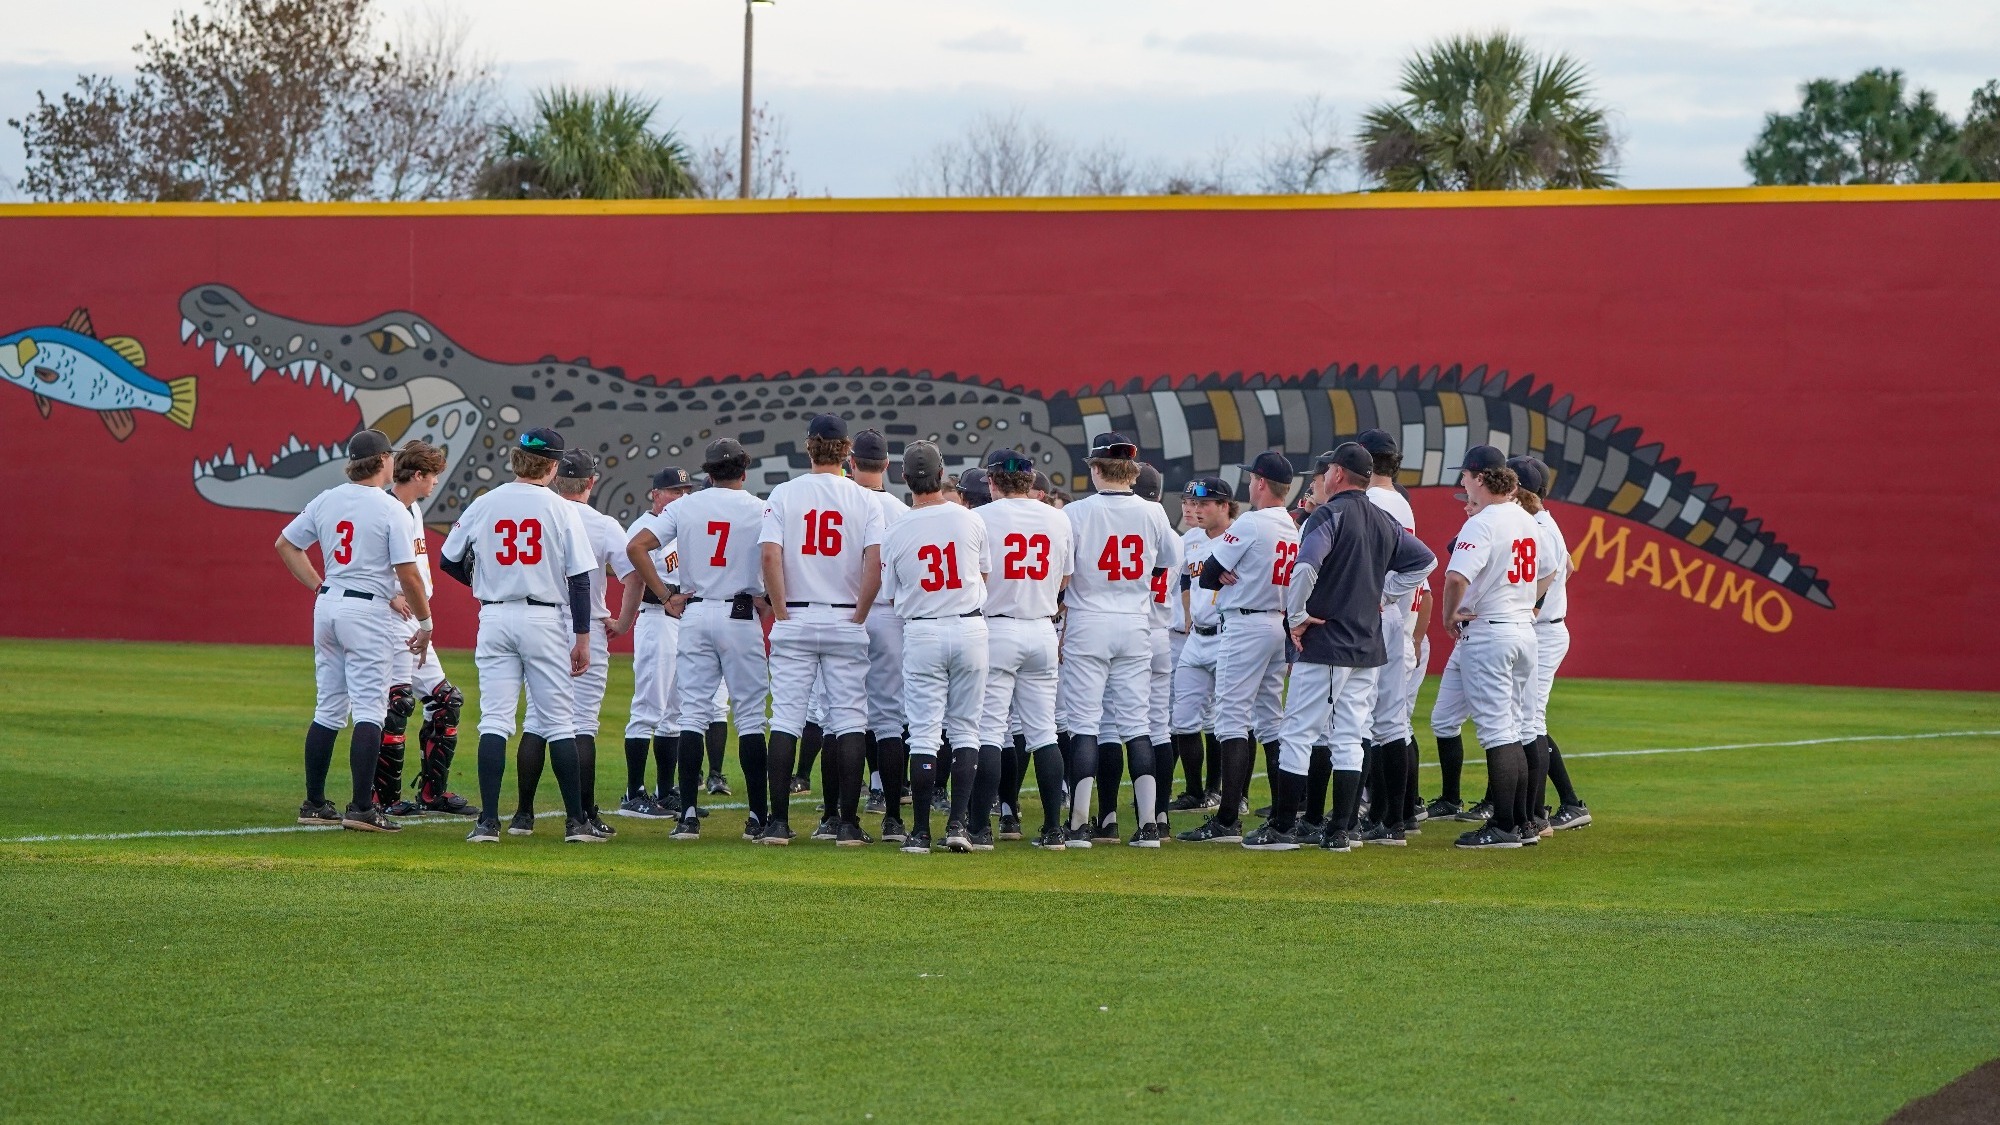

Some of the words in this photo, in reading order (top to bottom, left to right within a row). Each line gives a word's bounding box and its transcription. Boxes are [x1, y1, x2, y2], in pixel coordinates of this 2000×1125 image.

[334, 520, 354, 565] 3
[494, 518, 542, 566] 33
[707, 521, 730, 567] 7
[801, 509, 843, 557] 16
[917, 541, 963, 593] 31
[1004, 533, 1051, 581] 23
[1098, 534, 1144, 581] 43
[1272, 540, 1298, 587] 22
[1507, 537, 1536, 584] 38
[1571, 516, 1793, 633] MAXIMO
